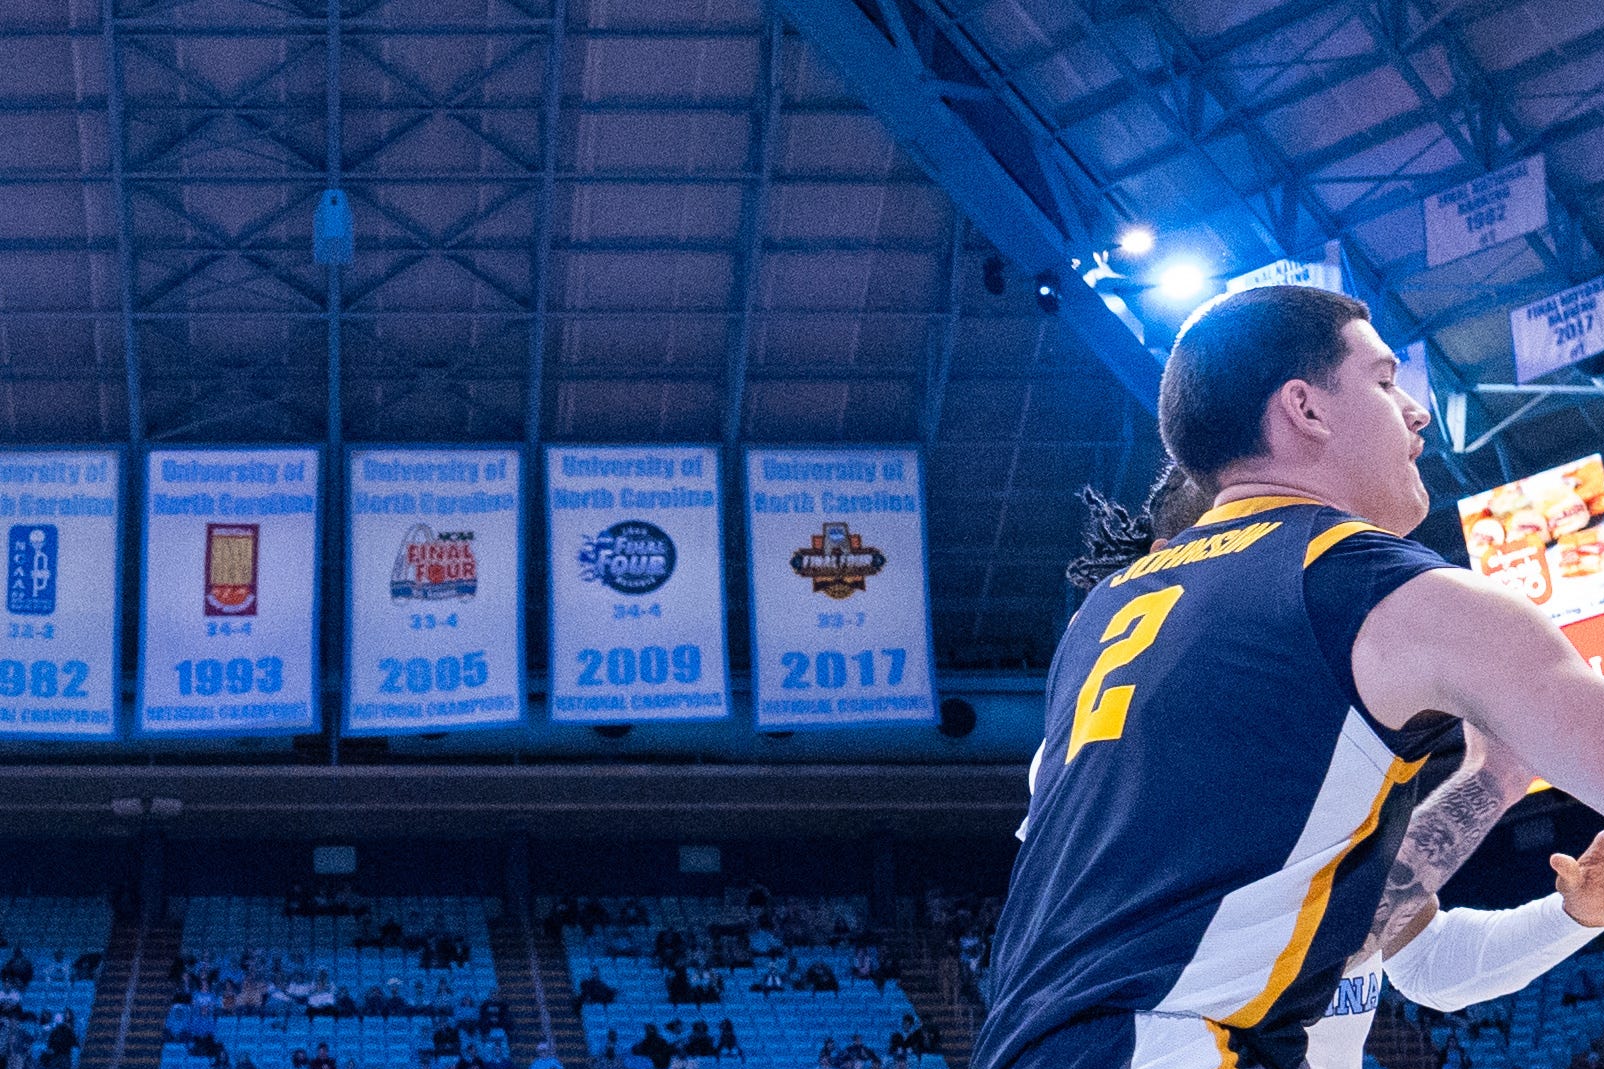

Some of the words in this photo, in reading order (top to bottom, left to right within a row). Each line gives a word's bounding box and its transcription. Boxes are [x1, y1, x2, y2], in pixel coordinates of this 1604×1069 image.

[1555, 314, 1593, 346] 2017
[162, 460, 279, 484] University
[363, 459, 479, 483] University
[562, 456, 675, 479] University
[763, 458, 876, 483] University
[153, 494, 214, 516] North
[218, 493, 313, 515] Carolina
[354, 492, 416, 515] North
[419, 491, 514, 515] Carolina
[553, 488, 614, 509] North
[619, 487, 714, 509] Carolina
[753, 492, 814, 513] North
[822, 491, 917, 514] Carolina
[407, 543, 475, 564] FINAL
[600, 551, 667, 574] FOUR
[1109, 521, 1282, 588] JOHNSON
[173, 655, 284, 697] 1993
[378, 651, 488, 694] 2005
[576, 643, 702, 687] 2009
[781, 648, 906, 689] 2017
[1065, 584, 1185, 765] 2
